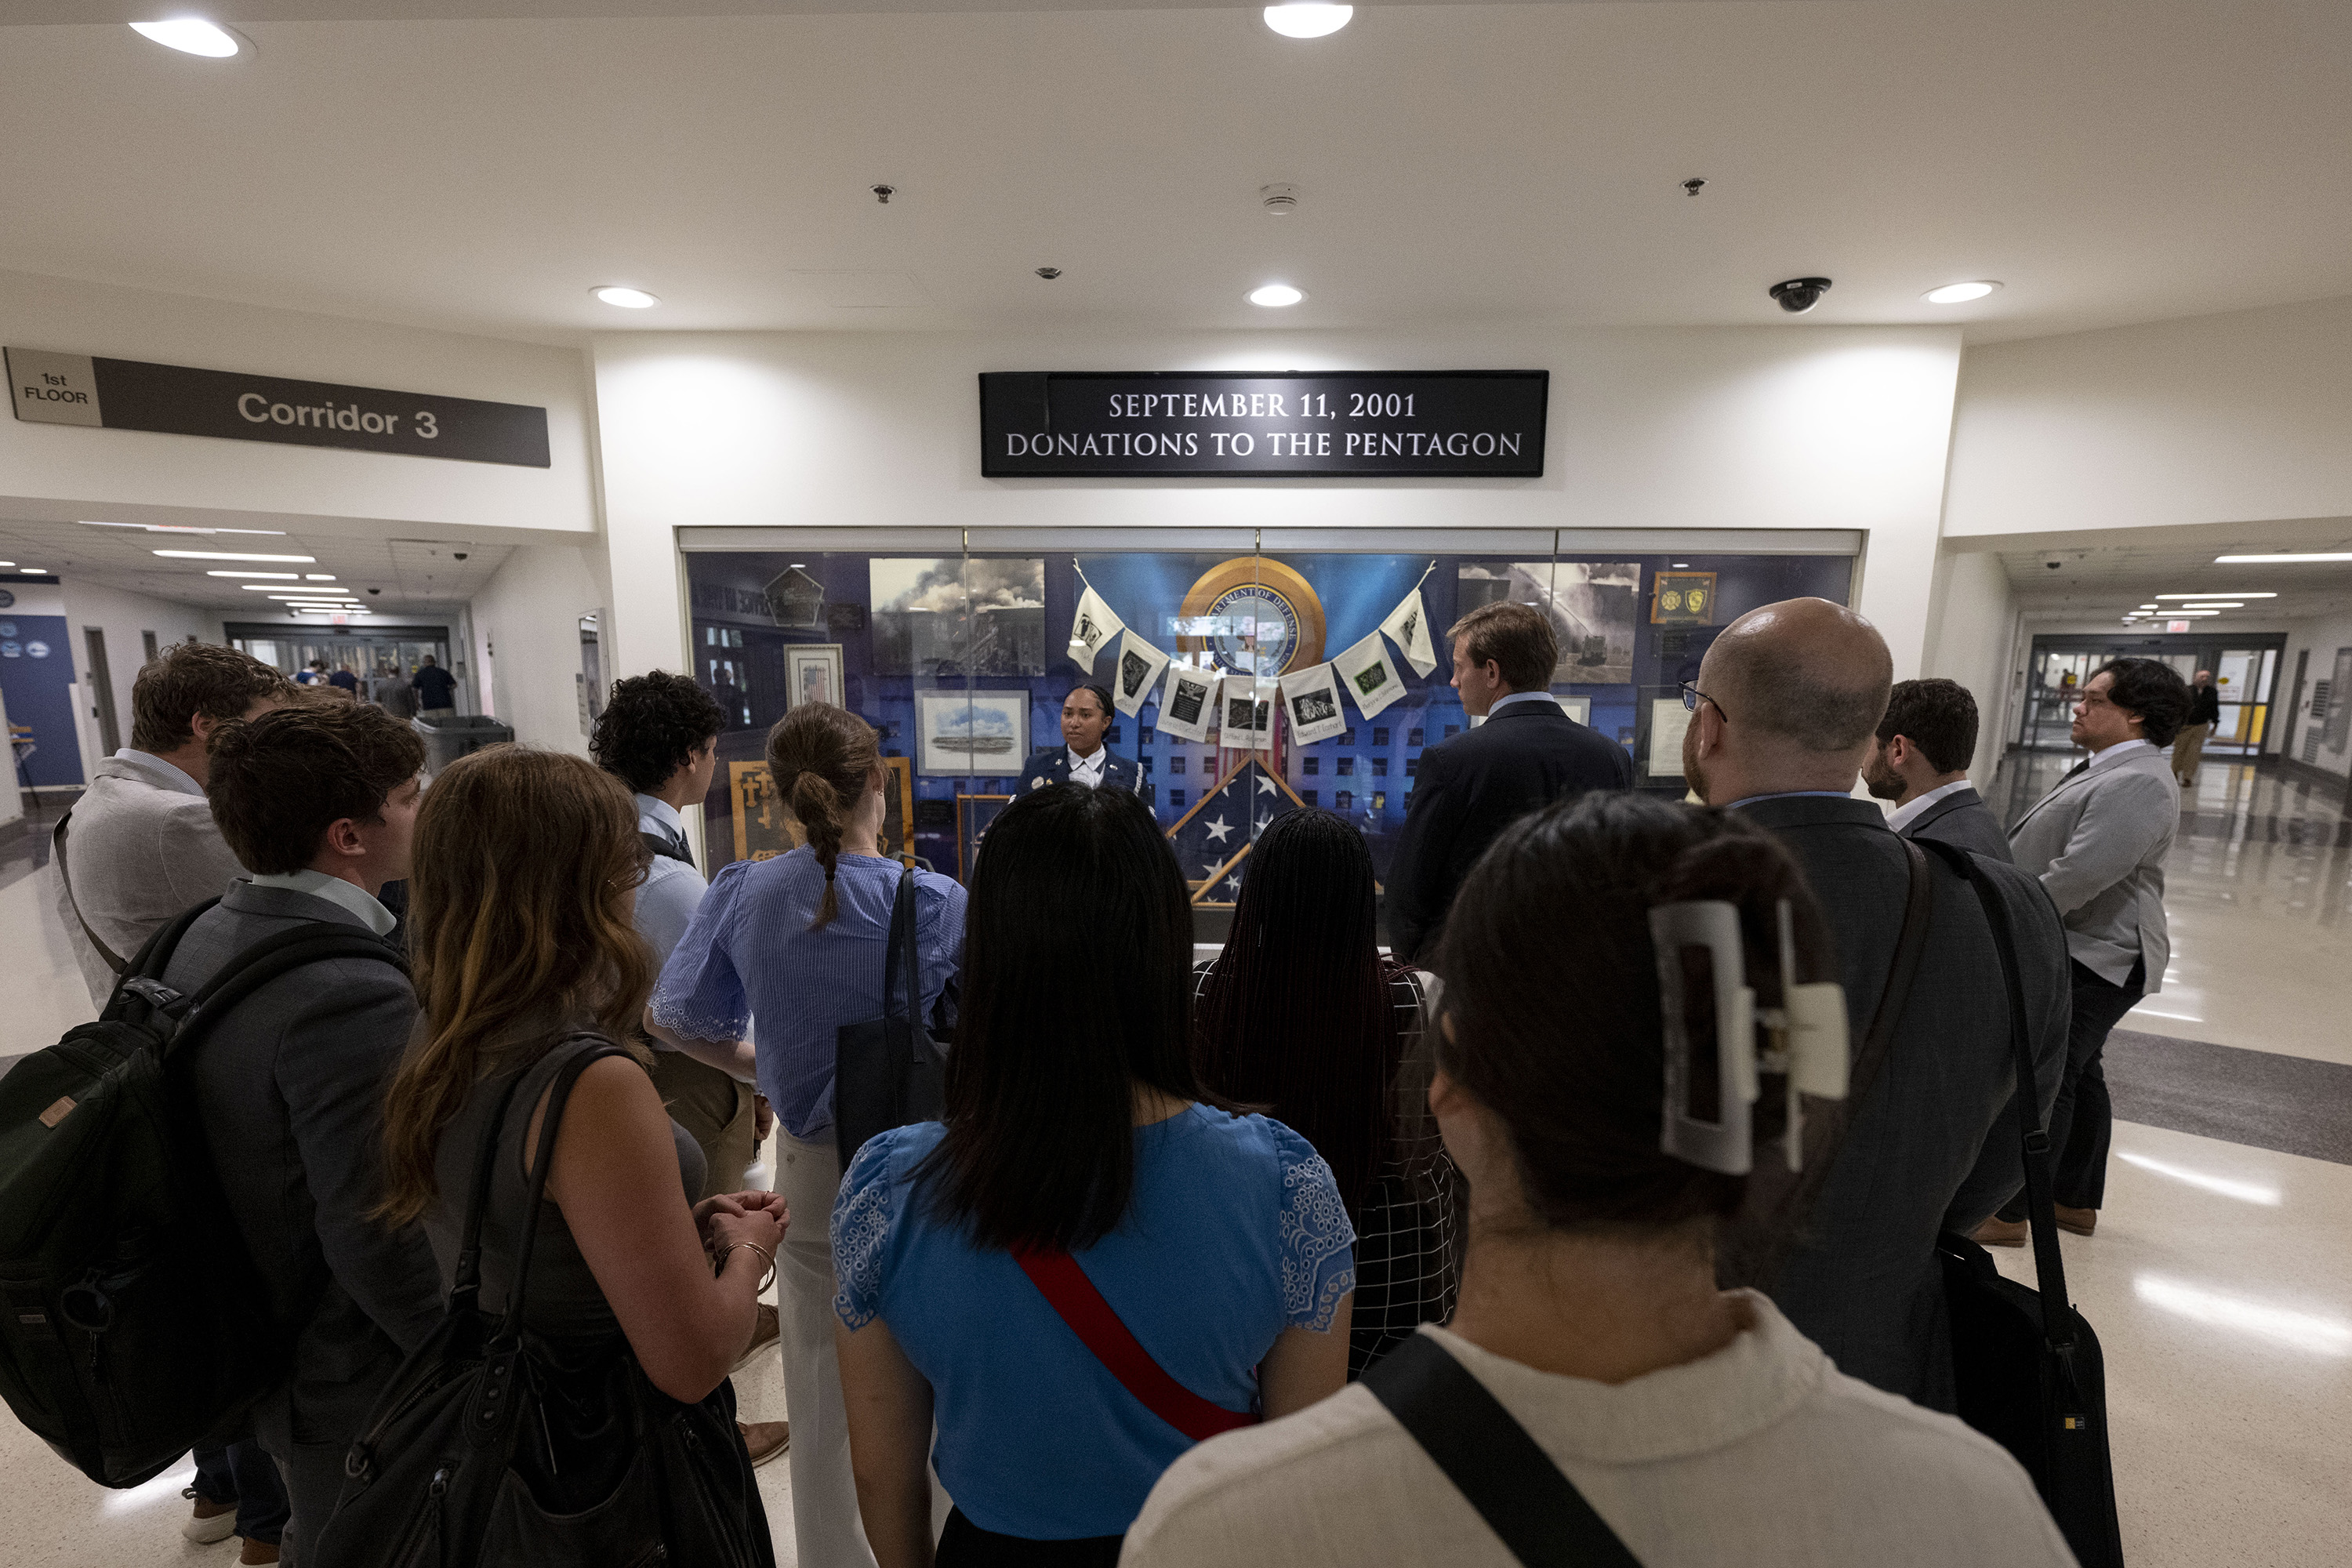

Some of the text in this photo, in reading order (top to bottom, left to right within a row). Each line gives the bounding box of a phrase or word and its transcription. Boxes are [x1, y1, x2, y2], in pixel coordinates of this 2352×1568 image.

[41, 372, 67, 387] 1st
[24, 387, 88, 405] FLOOR
[1109, 393, 1416, 419] SEPTEMBER 11, 2001
[237, 392, 439, 439] Corridor 3
[1006, 432, 1523, 456] DONATIONS TO THE PENTAGON
[1258, 588, 1272, 600] OF
[1272, 597, 1298, 640] DEFENSE
